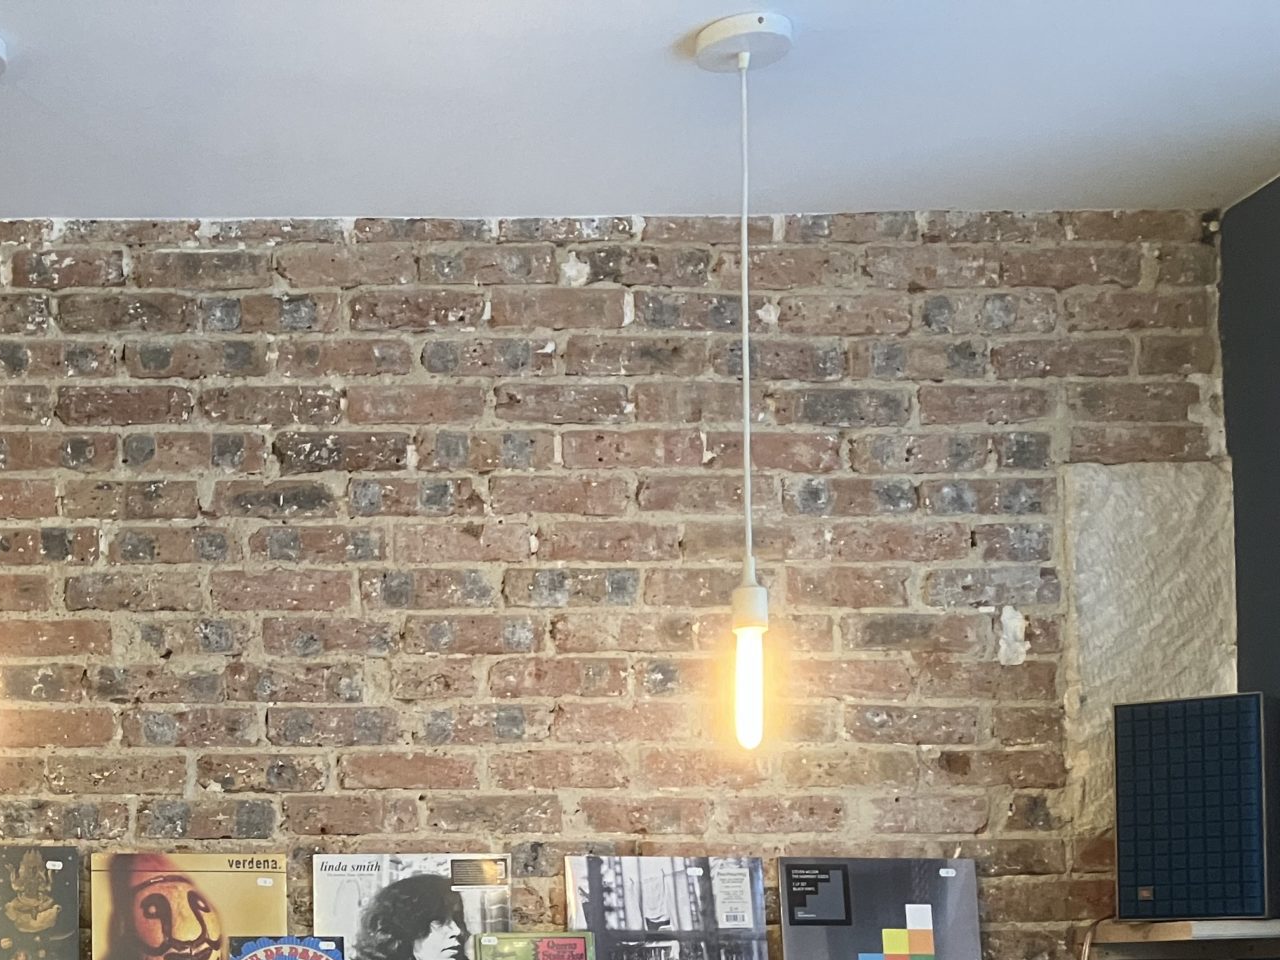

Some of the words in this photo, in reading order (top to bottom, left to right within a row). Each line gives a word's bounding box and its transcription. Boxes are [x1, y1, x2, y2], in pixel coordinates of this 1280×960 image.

[227, 857, 282, 869] verdena.
[320, 860, 347, 872] linda
[351, 860, 381, 872] smith
